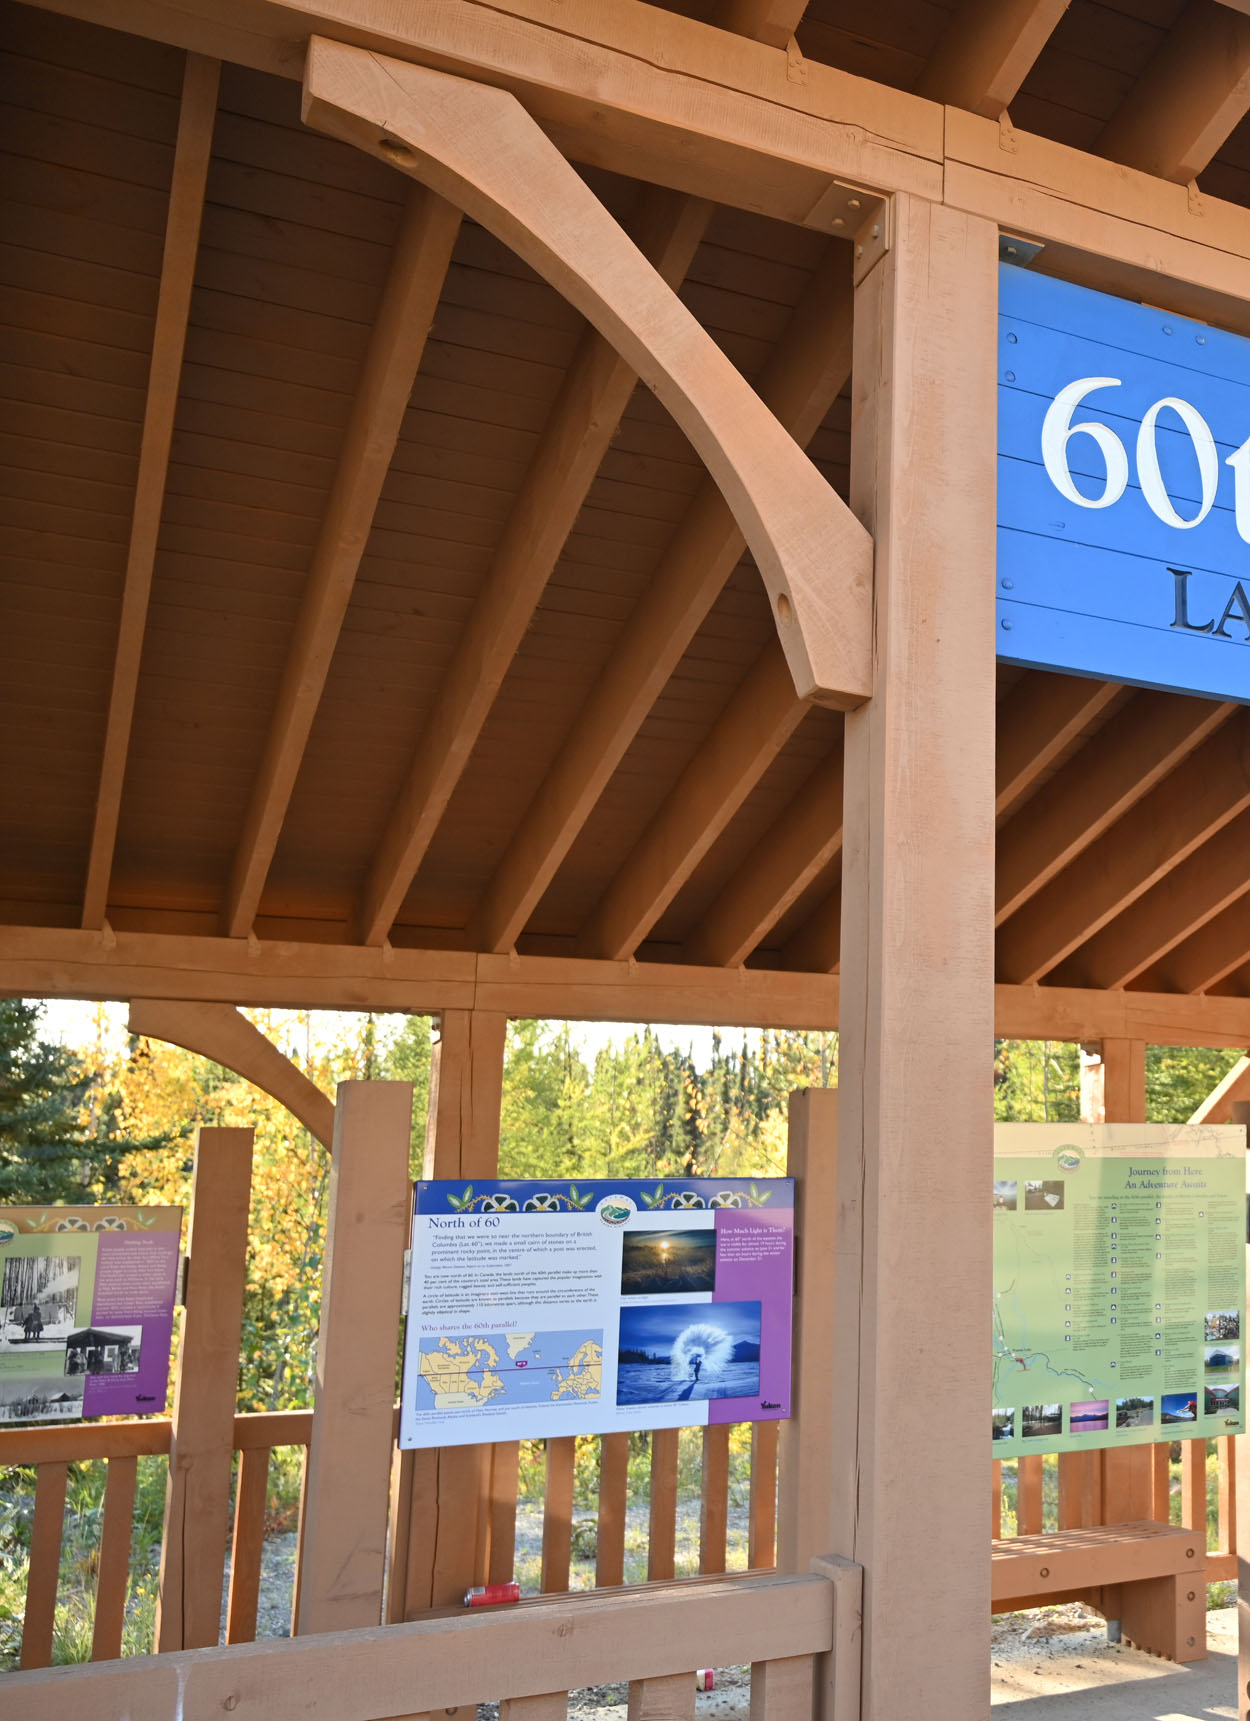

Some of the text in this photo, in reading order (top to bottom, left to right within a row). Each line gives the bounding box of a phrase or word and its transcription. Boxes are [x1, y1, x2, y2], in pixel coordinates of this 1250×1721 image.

[1129, 1166, 1204, 1178] Journey from Here
[1125, 1180, 1137, 1189] An
[1139, 1180, 1178, 1189] Adventure
[429, 1216, 500, 1228] North of 60
[491, 1321, 518, 1330] parallel?
[760, 1400, 781, 1409] Yukon
